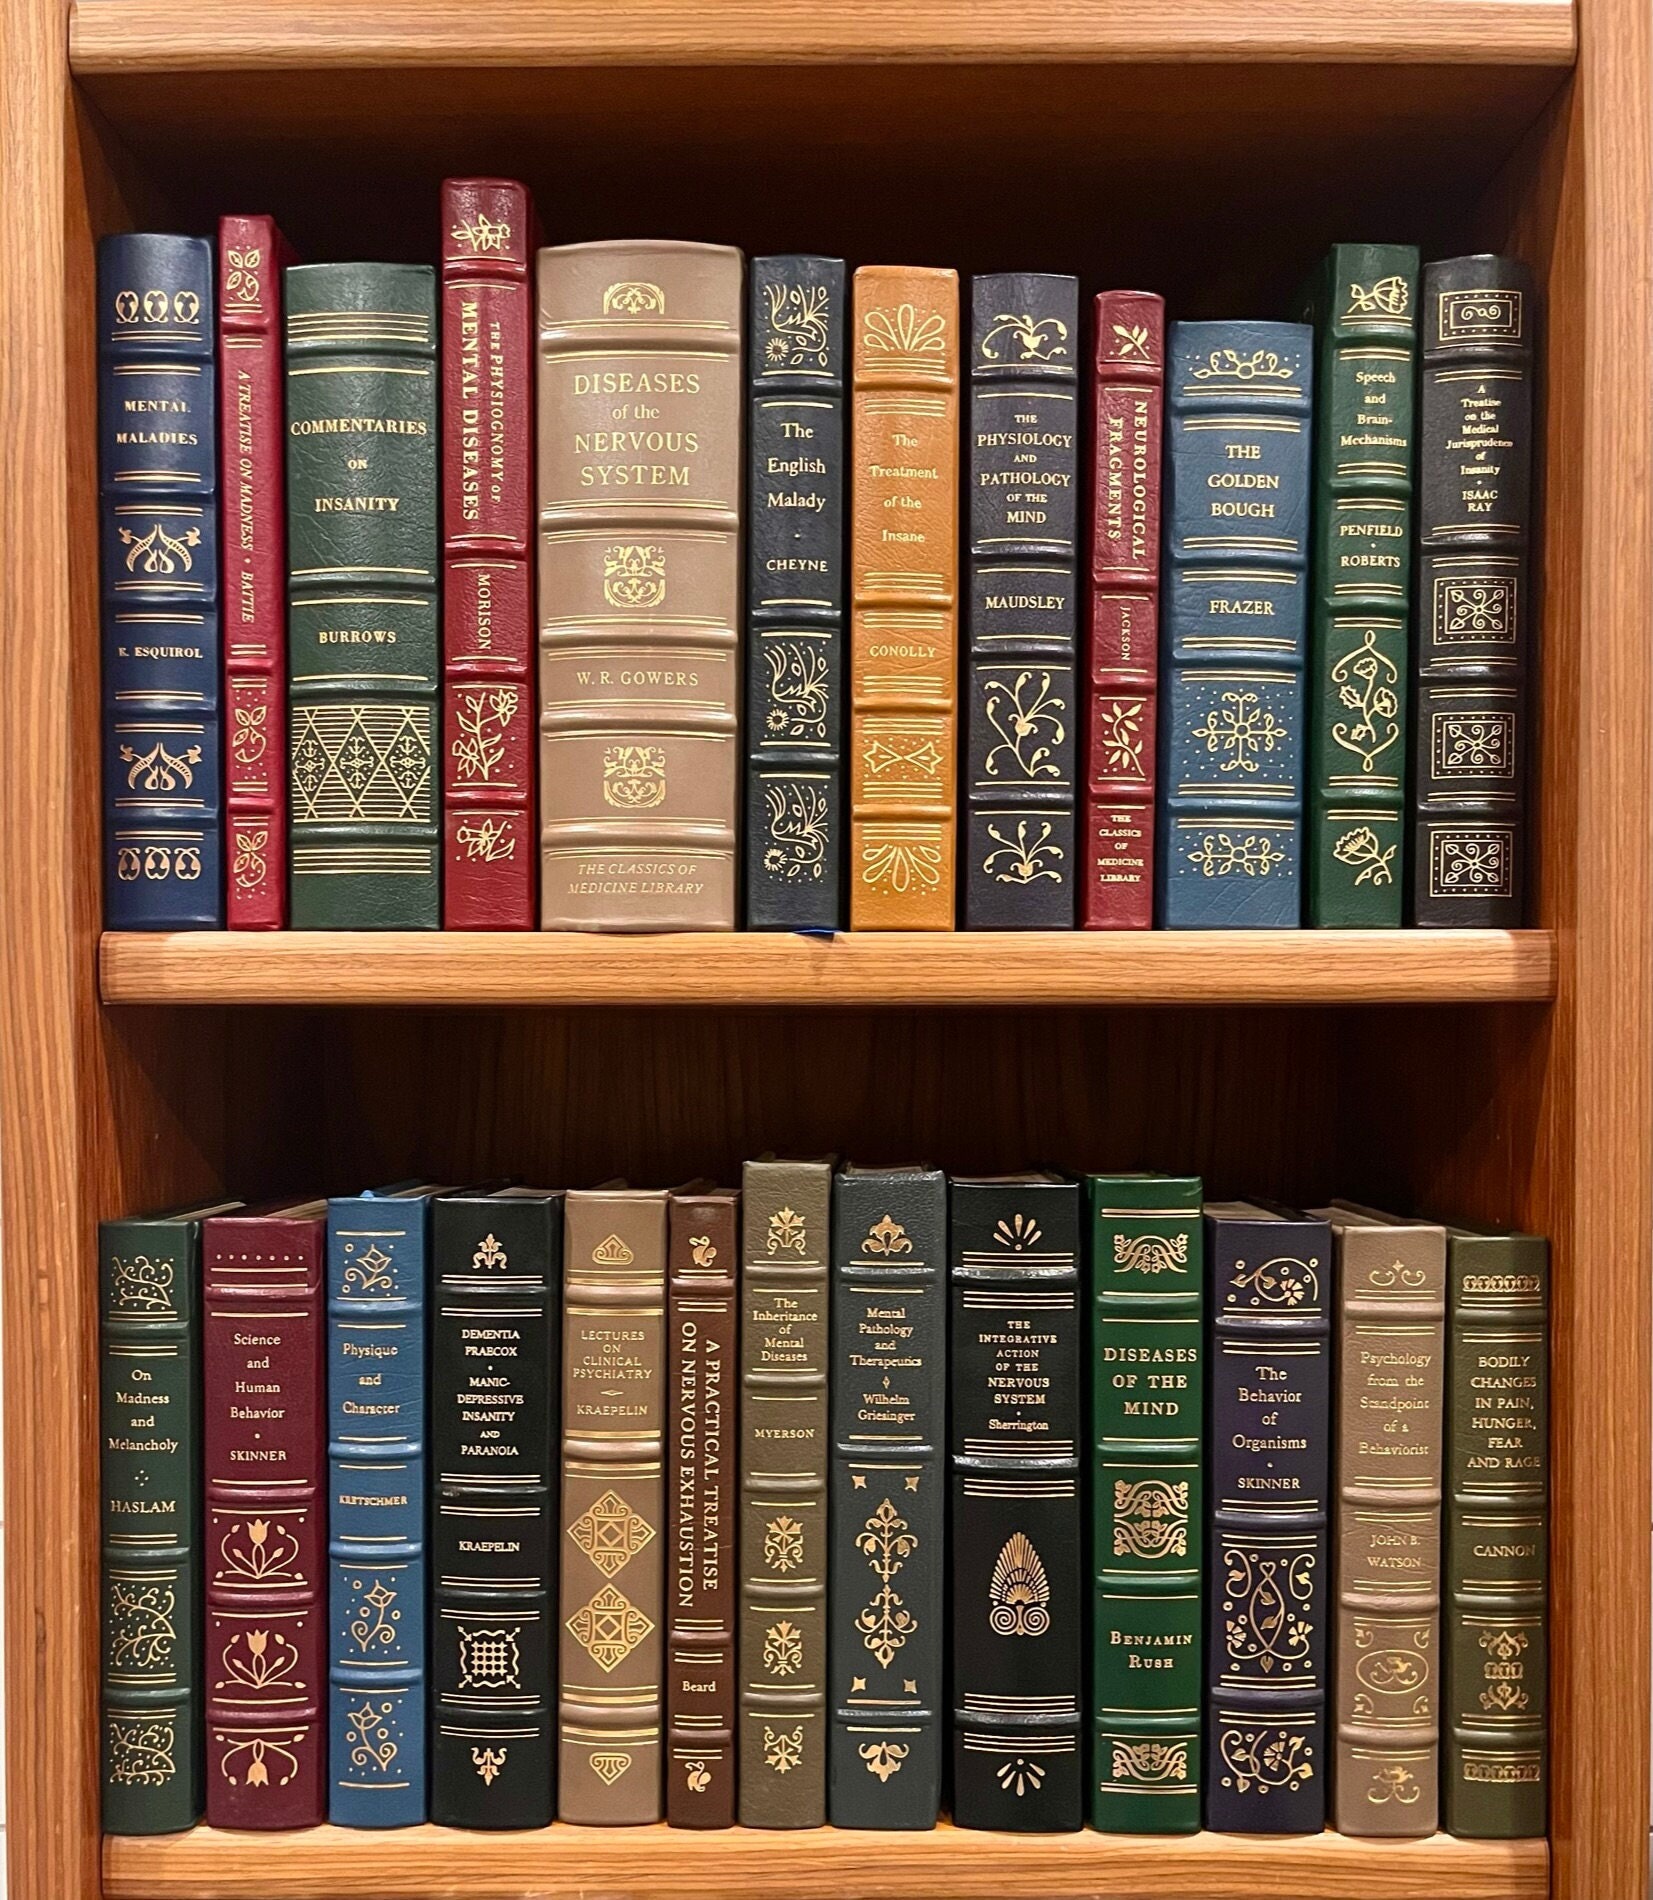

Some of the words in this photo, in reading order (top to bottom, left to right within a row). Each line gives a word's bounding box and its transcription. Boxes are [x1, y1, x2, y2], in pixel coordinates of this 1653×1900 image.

[489, 321, 500, 350] THE
[462, 302, 479, 400] MENTAL
[238, 370, 251, 379] A
[1356, 372, 1396, 384] Speech
[573, 373, 700, 395] DISEASES
[1477, 384, 1486, 394] A
[1364, 393, 1386, 404] and
[1460, 398, 1502, 408] Treatise
[612, 404, 629, 419] of
[634, 404, 660, 419] the
[1464, 413, 1477, 421] on
[1480, 411, 1496, 421] the
[239, 384, 253, 454] TREATISE
[490, 354, 504, 482] PHYSIOGNOMY
[1014, 414, 1037, 424] THE
[1357, 414, 1393, 425] Brain-
[290, 418, 427, 435] COMMENTARIES
[781, 423, 814, 439] The
[1462, 424, 1499, 434] Medical
[116, 433, 198, 445] MALADIES
[574, 431, 699, 453] NERVOUS
[892, 434, 919, 447] The
[977, 432, 1072, 448] PHYSIOLOGY
[1340, 435, 1407, 447] Mechanisms
[1225, 444, 1261, 459] THE
[1475, 451, 1487, 461] of
[348, 459, 368, 469] ON
[1014, 454, 1037, 463] AND
[240, 458, 253, 480] ON
[463, 410, 479, 521] DISEASES
[768, 457, 826, 477] English
[1460, 465, 1500, 475] Insanity
[580, 465, 690, 486] SYSTEM
[869, 465, 938, 479] Treatment
[980, 472, 1071, 487] PATHOLOGY
[1108, 417, 1123, 540] FRAGMENTS
[1132, 400, 1148, 560] NEUROLOGICAL
[1207, 473, 1279, 489] GOLDEN
[491, 485, 502, 502] OF
[1006, 493, 1022, 502] OF
[1025, 493, 1048, 503] THE
[1462, 490, 1498, 500] ISAAC
[315, 497, 399, 512] INSANITY
[768, 492, 826, 512] Malady
[884, 496, 897, 508] of
[901, 496, 922, 509] the
[1468, 502, 1493, 512] RAY
[240, 480, 254, 551] MADNESS
[1211, 502, 1275, 518] BOUGH
[1007, 511, 1046, 523] MIND
[882, 529, 925, 542] Insane
[1339, 525, 1403, 537] PENFIELD
[766, 559, 828, 572] CHEYNE
[1340, 555, 1401, 568] ROBERTS
[242, 571, 254, 623] BATTIE
[985, 596, 1064, 610] MAUDSLEY
[478, 574, 491, 650] MORISON
[1209, 599, 1275, 615] FRAZER
[319, 631, 396, 644] BURROWS
[1119, 606, 1131, 661] JACKSON
[134, 646, 203, 659] ESQUIROL
[869, 645, 936, 657] CONOLLY
[577, 672, 595, 685] W.
[600, 671, 614, 684] R.
[620, 672, 699, 686] GOWERS
[1098, 828, 1142, 837] CLASSICS
[1114, 842, 1128, 850] OF
[1097, 858, 1144, 867] MEDICINE
[578, 864, 605, 875] THE
[608, 863, 675, 875] CLASSICS
[678, 865, 697, 875] OF
[1100, 874, 1141, 882] LIBRARY
[568, 883, 637, 894] MEDICINE
[640, 883, 703, 895] LIBRARY
[774, 1298, 798, 1309] The
[752, 1311, 818, 1323] Inheritance
[866, 1308, 906, 1318] Mental
[778, 1324, 792, 1335] of
[859, 1324, 914, 1338] Pathology
[1007, 1321, 1030, 1329] THE
[233, 1333, 281, 1345] Science
[461, 1329, 520, 1340] DEMENTIA
[581, 1330, 645, 1341] LECTURES
[681, 1322, 697, 1352] ON
[978, 1334, 1057, 1343] INTEGRATIVE
[603, 1344, 621, 1353] ON
[705, 1339, 721, 1352] A
[764, 1337, 804, 1348] Mental
[874, 1340, 896, 1351] and
[343, 1343, 398, 1358] Physique
[465, 1346, 517, 1357] PRAECOX
[760, 1350, 808, 1362] Diseases
[996, 1350, 1039, 1358] ACTION
[1103, 1347, 1197, 1362] DISEASES
[246, 1356, 270, 1369] and
[583, 1356, 642, 1366] CLINICAL
[850, 1355, 922, 1368] Therapeutics
[1361, 1352, 1431, 1367] Psychology
[1478, 1356, 1530, 1368] BODILY
[995, 1363, 1010, 1372] OF
[1016, 1363, 1039, 1372] THE
[131, 1369, 152, 1381] On
[359, 1374, 382, 1386] and
[572, 1368, 652, 1380] PSYCHIATRY
[1255, 1367, 1287, 1381] The
[1367, 1374, 1399, 1386] from
[1405, 1375, 1424, 1386] the
[235, 1381, 281, 1393] Human
[469, 1377, 510, 1387] MANIC-
[987, 1377, 1050, 1388] NERVOUS
[1112, 1375, 1138, 1388] OF
[1147, 1375, 1188, 1389] THE
[1470, 1376, 1537, 1389] CHANGES
[116, 1392, 170, 1404] Madness
[457, 1394, 524, 1405] DEPRESSIVE
[862, 1394, 910, 1405] Wilhelm
[994, 1394, 1046, 1404] SYSTEM
[1238, 1388, 1302, 1403] Behavior
[342, 1401, 400, 1414] Character
[680, 1359, 697, 1460] NERVOUS
[1124, 1402, 1179, 1416] MIND
[1475, 1397, 1492, 1409] IN
[1497, 1397, 1534, 1411] PAIN,
[230, 1406, 285, 1419] Behavior
[462, 1411, 516, 1422] INSANITY
[577, 1405, 648, 1416] KRAEPELIN
[858, 1410, 916, 1423] Griesinger
[130, 1416, 155, 1427] and
[704, 1360, 720, 1481] PRACTICAL
[1262, 1411, 1278, 1425] of
[1471, 1417, 1537, 1431] HUNGER,
[988, 1419, 1049, 1432] Sherrington
[1384, 1420, 1398, 1432] of
[1401, 1424, 1409, 1432] a
[480, 1430, 500, 1439] AND
[754, 1428, 816, 1439] MYERSON
[108, 1438, 178, 1454] Melancholy
[1232, 1434, 1307, 1452] Organisms
[1359, 1442, 1429, 1455] Behaviorist
[1487, 1437, 1523, 1449] FEAR
[230, 1450, 287, 1462] SKINNER
[460, 1445, 519, 1456] PARANOIA
[1466, 1456, 1500, 1469] AND
[1504, 1456, 1541, 1469] RAGE
[1237, 1478, 1301, 1489] SKINNER
[110, 1501, 176, 1514] HASLAM
[678, 1466, 695, 1607] EXHAUSTION
[703, 1485, 719, 1591] TREATISE
[1370, 1534, 1408, 1547] JOHN
[459, 1541, 520, 1552] KRAEPELIN
[1473, 1545, 1536, 1557] CANNON
[1367, 1557, 1422, 1568] WATSON
[1110, 1631, 1192, 1645] BENJAMIN
[1128, 1654, 1174, 1669] RUSH
[682, 1680, 716, 1692] Beard
